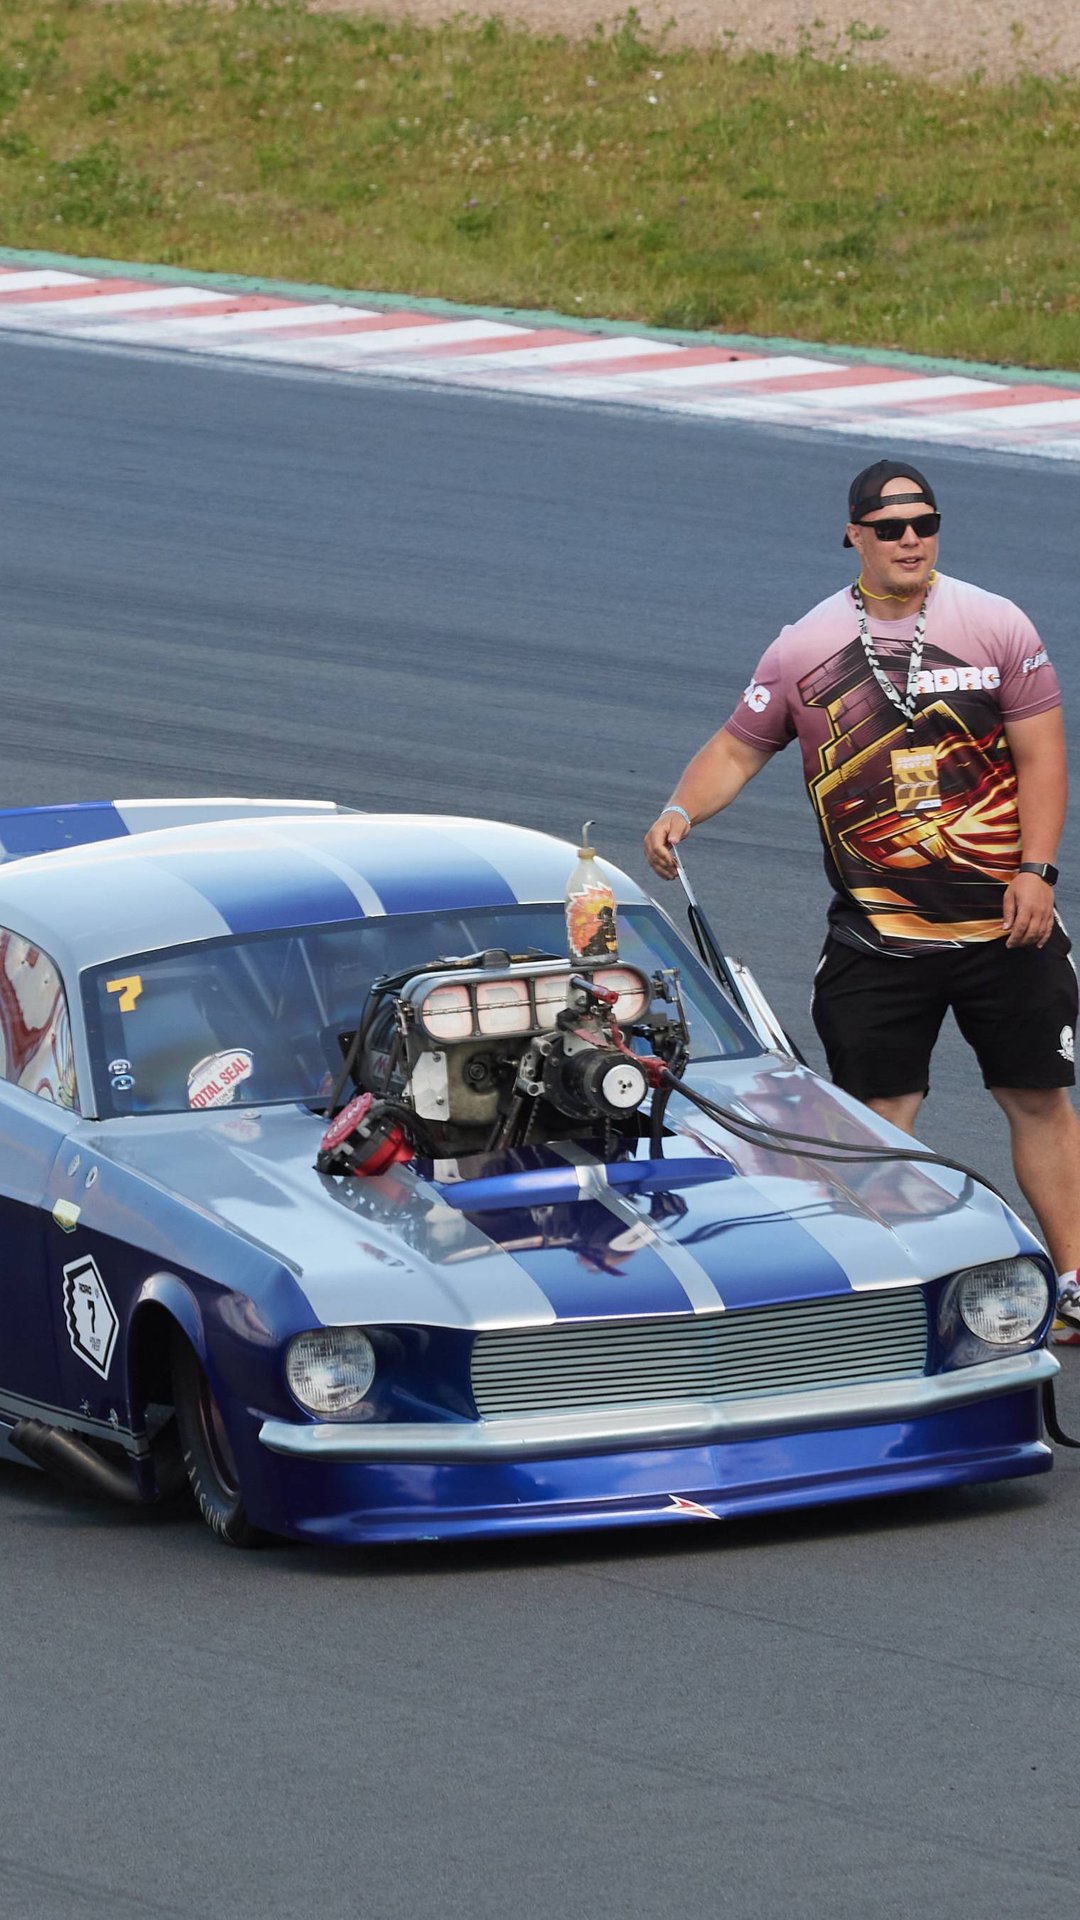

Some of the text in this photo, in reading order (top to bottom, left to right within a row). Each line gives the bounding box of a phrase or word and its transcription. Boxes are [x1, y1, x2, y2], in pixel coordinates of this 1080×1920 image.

[106, 975, 143, 1013] 7
[189, 1080, 224, 1109] TOTAL
[219, 1058, 249, 1085] SEAL
[87, 1299, 96, 1334] 7
